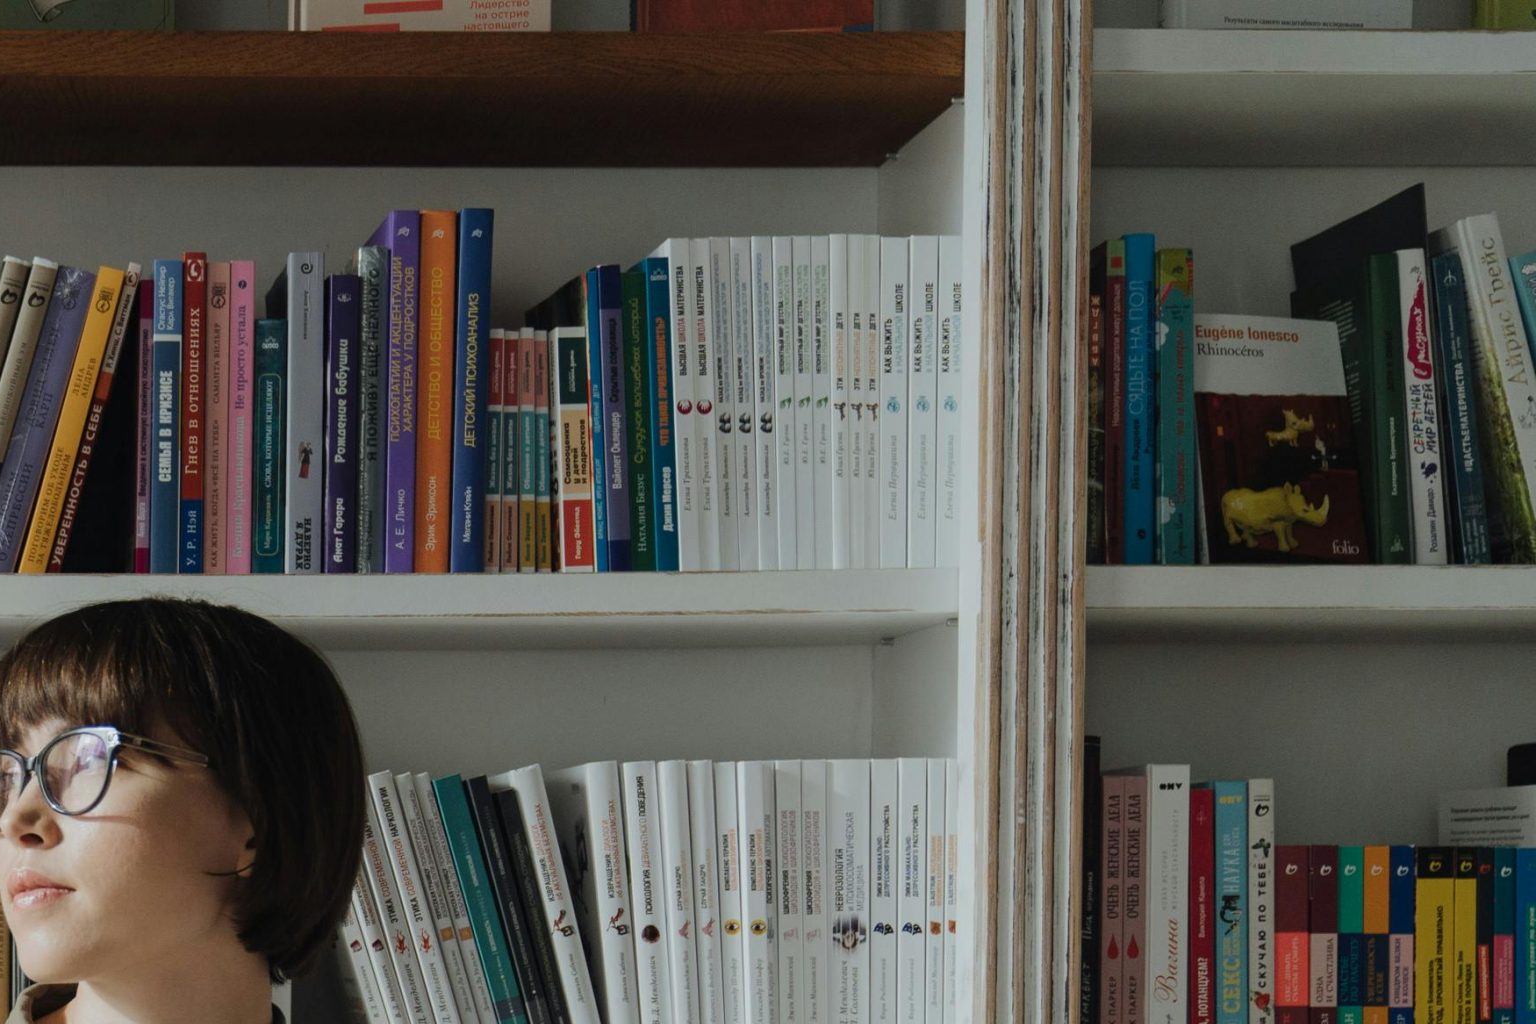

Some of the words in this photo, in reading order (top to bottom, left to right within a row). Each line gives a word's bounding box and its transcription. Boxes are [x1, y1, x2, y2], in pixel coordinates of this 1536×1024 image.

[391, 256, 403, 345] АКЦЕНТУАЦИИ
[404, 267, 415, 350] ПОДРОСТКОВ
[430, 266, 445, 352] ОБЩЕСТВО
[1129, 281, 1144, 321] ПОЛ
[237, 305, 248, 347] устала
[465, 293, 479, 386] ПСИХОАНАЛИЗ
[1129, 326, 1144, 348] НА
[1196, 325, 1245, 341] Eugène
[1248, 326, 1298, 343] Ionesco
[187, 308, 200, 412] отношениях
[236, 349, 248, 391] просто
[336, 339, 349, 395] бабушки
[391, 348, 401, 357] И
[404, 353, 414, 362] У
[430, 356, 442, 366] И
[1197, 343, 1264, 358] Rhinocéros
[159, 370, 173, 424] КРИЗИСЕ
[234, 394, 246, 409] Не
[389, 360, 401, 441] ПСИХОПАТИИ
[403, 364, 414, 432] ХАРАКТЕРА
[427, 369, 442, 440] ДЕТСТВО
[1129, 356, 1145, 415] СЯДЬТЕ
[1422, 383, 1435, 423] ДЕТЕЙ
[85, 404, 103, 441] СЕБЕ
[159, 428, 172, 437] В
[189, 419, 199, 428] в
[334, 399, 348, 463] Рождение
[464, 389, 478, 447] ДЕТСКИЙ
[1409, 384, 1425, 454] СЕКРЕТНЫЙ
[81, 445, 92, 455] В
[159, 441, 172, 482] СЕМЬЯ
[185, 435, 199, 475] Гнев
[1425, 427, 1437, 454] МИР
[52, 459, 88, 565] УВЕРЕННОСТЬ
[1333, 540, 1359, 555] folio
[377, 787, 399, 838] НАРКОЛОГИИ
[1107, 794, 1121, 822] ДЕЛА
[392, 838, 416, 896] СОВРЕМЕННОЙ
[1107, 828, 1120, 879] ЖЕНСКИЕ
[834, 848, 844, 912] НЕВРОЗОЛОГИЯ
[1258, 863, 1267, 896] ТЕБЕ
[408, 897, 423, 922] ЭТИКА
[1106, 884, 1119, 919] ОЧЕНЬ
[1258, 905, 1267, 922] ПО
[1153, 918, 1179, 1003] Вагина
[1258, 930, 1267, 988] СКУЧАЮ
[1108, 976, 1117, 1016] ПАРКЕР
[1197, 958, 1209, 1017] ПОТАНЦУЕМ?
